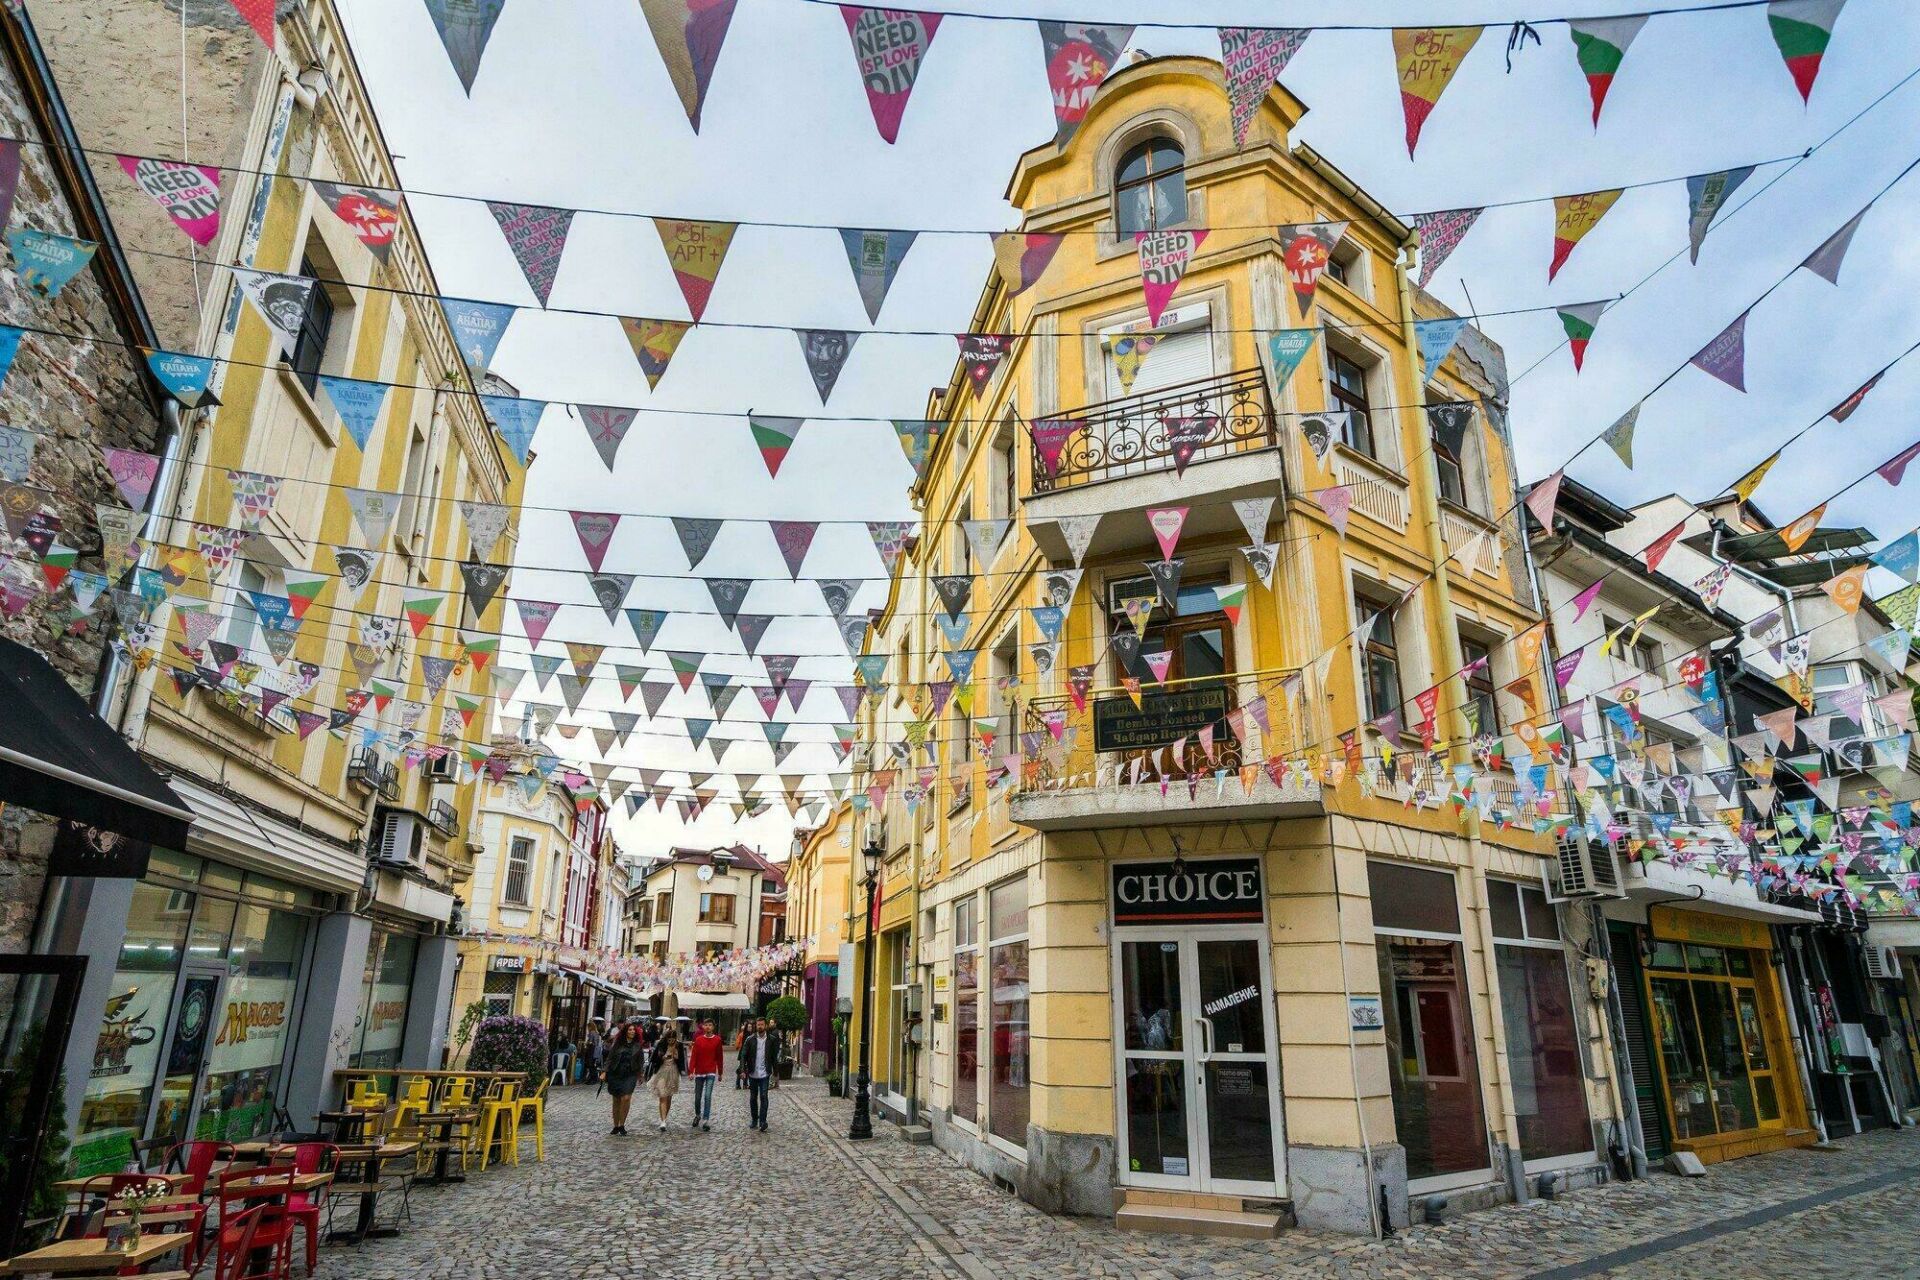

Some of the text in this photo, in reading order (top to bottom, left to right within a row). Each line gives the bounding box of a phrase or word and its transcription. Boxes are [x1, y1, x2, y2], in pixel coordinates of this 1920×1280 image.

[857, 20, 917, 58] NEED
[143, 169, 202, 196] NEED
[1142, 234, 1188, 259] NEED
[160, 361, 201, 374] КАПАНА
[1039, 435, 1067, 444] STORE
[1117, 871, 1258, 904] CHOICE
[1204, 985, 1260, 1016] НАМАЛЕНИЕ
